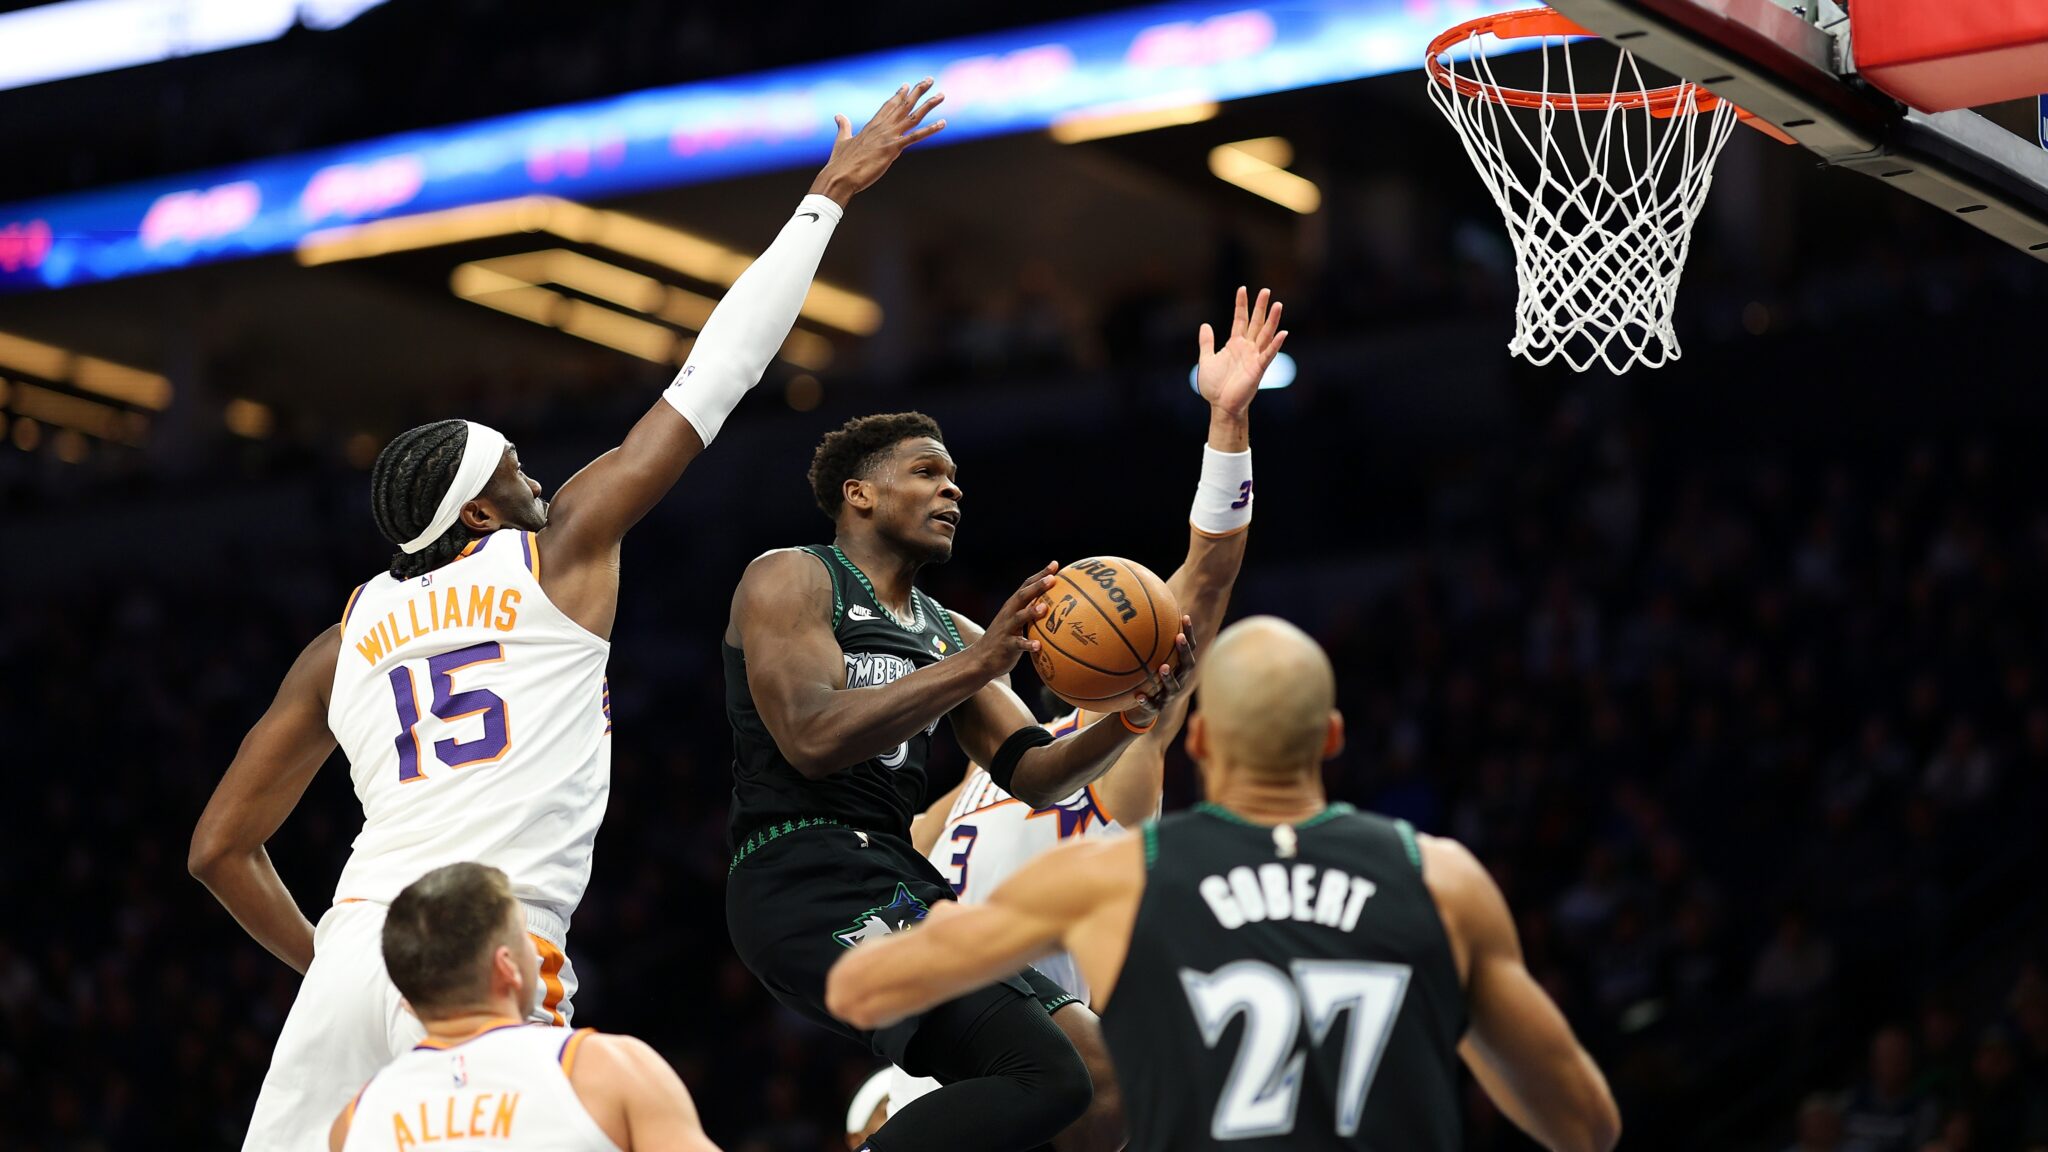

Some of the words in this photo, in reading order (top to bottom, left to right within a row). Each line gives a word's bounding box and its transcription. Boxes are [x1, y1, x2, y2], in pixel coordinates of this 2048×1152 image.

[1231, 480, 1252, 510] 3
[355, 584, 522, 667] WILLIAMS
[853, 603, 872, 617] NIKE
[1071, 558, 1138, 625] Wilson
[388, 640, 512, 785] 15
[945, 824, 978, 896] 3
[1199, 862, 1377, 933] GOBERT
[1180, 958, 1413, 1141] 27
[392, 1091, 520, 1152] ALLEN
